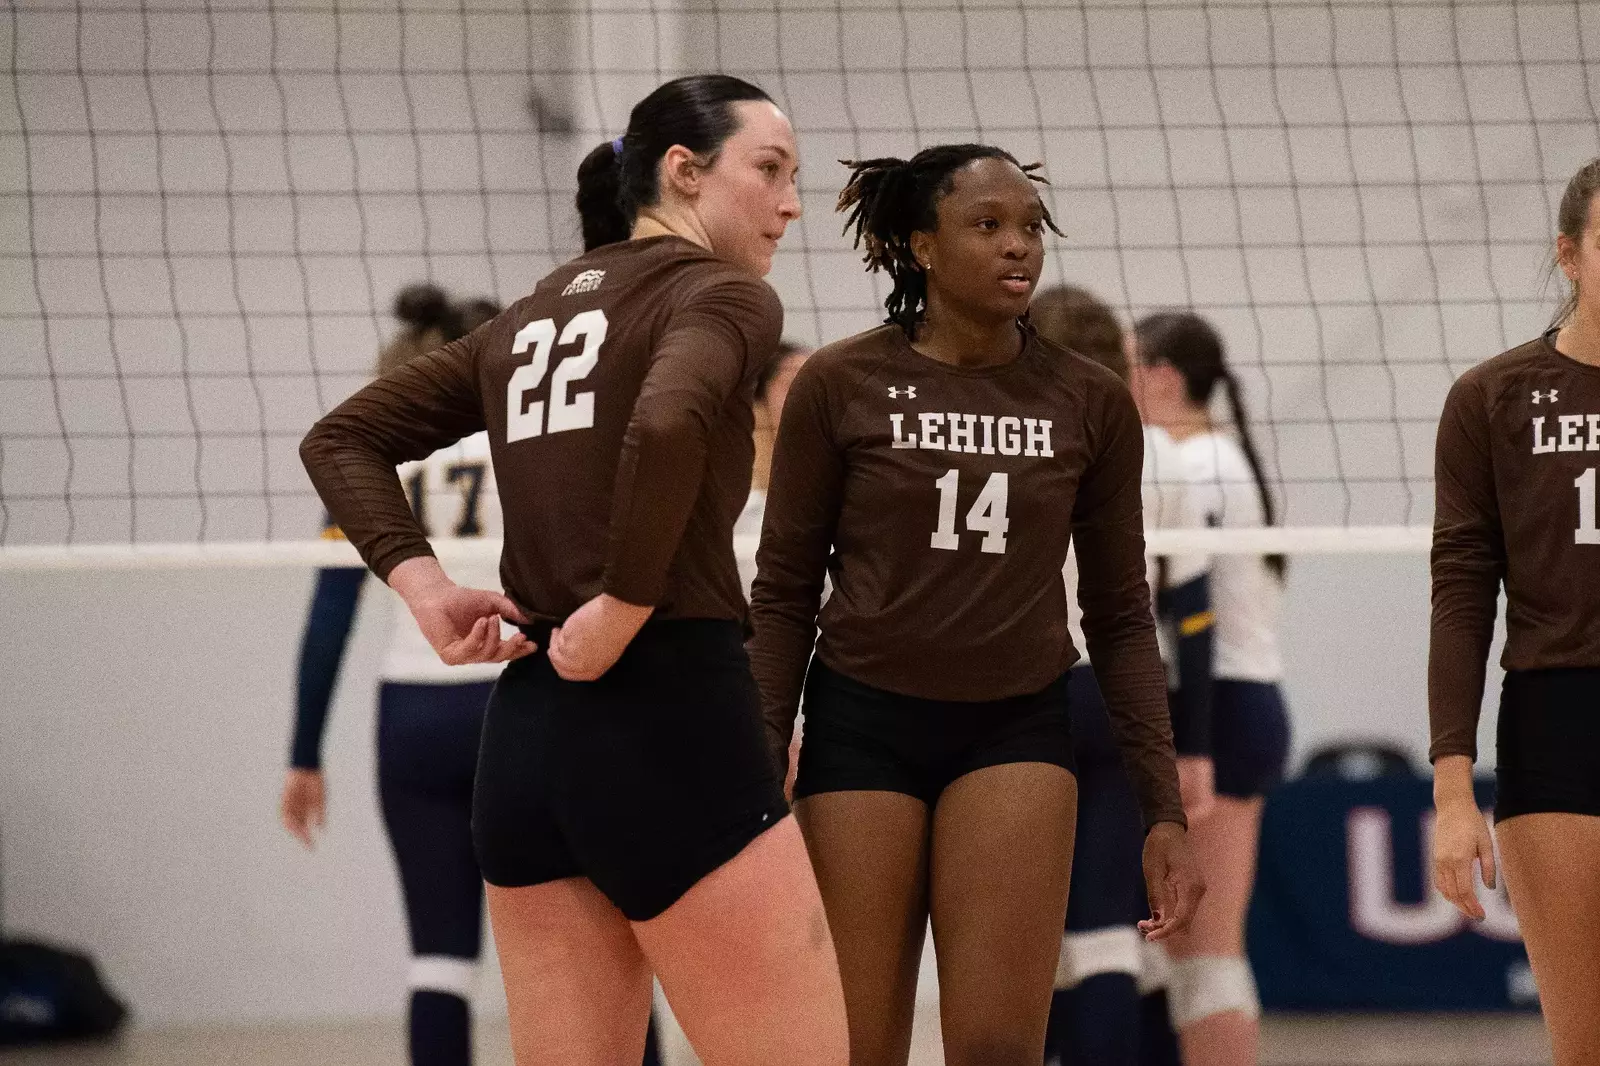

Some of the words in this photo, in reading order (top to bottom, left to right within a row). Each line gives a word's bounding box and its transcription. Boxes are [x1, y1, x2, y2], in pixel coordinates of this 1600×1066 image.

[507, 309, 609, 444] 22
[889, 412, 1055, 458] LEHIGH
[930, 468, 1010, 554] 14
